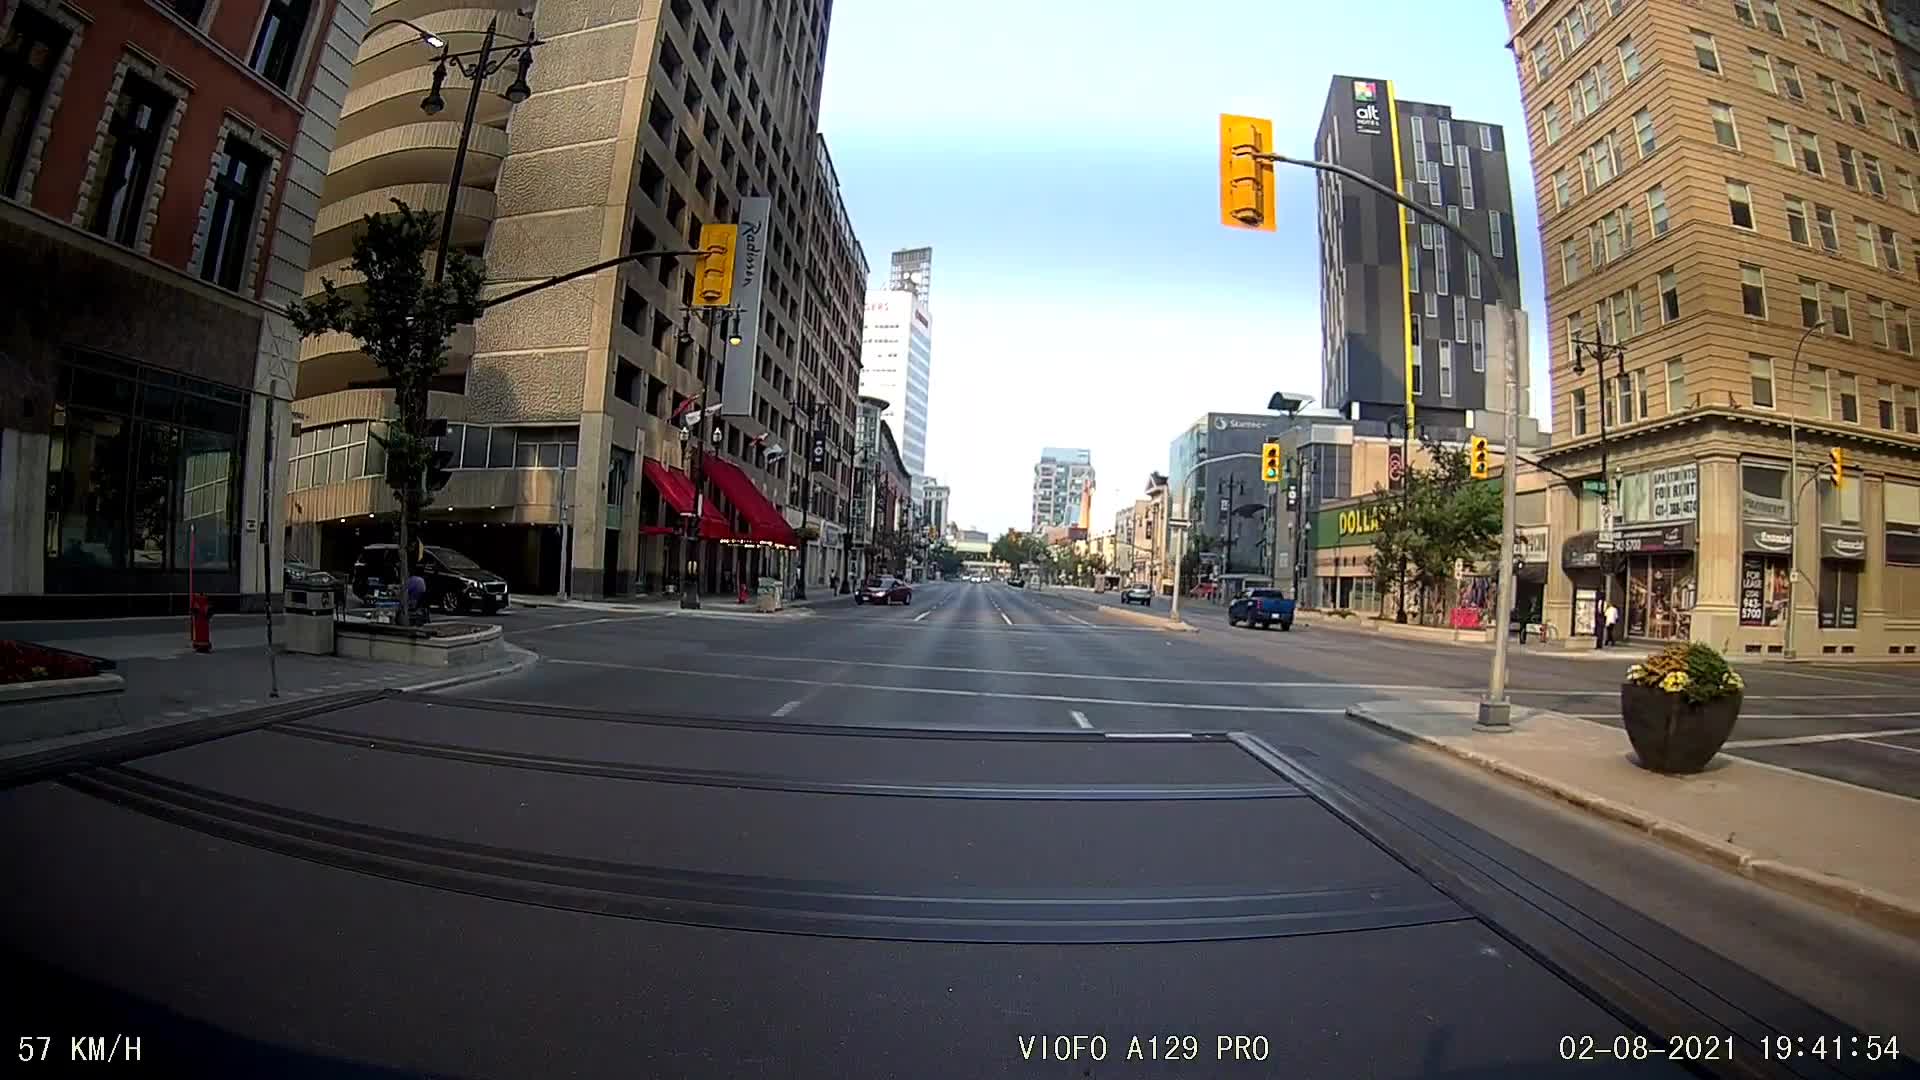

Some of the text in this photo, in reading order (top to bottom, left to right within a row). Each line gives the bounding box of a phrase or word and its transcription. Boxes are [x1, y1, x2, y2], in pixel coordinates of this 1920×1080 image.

[1356, 105, 1379, 120] alt
[741, 220, 761, 287] Radisson
[1742, 607, 1761, 619] 5700
